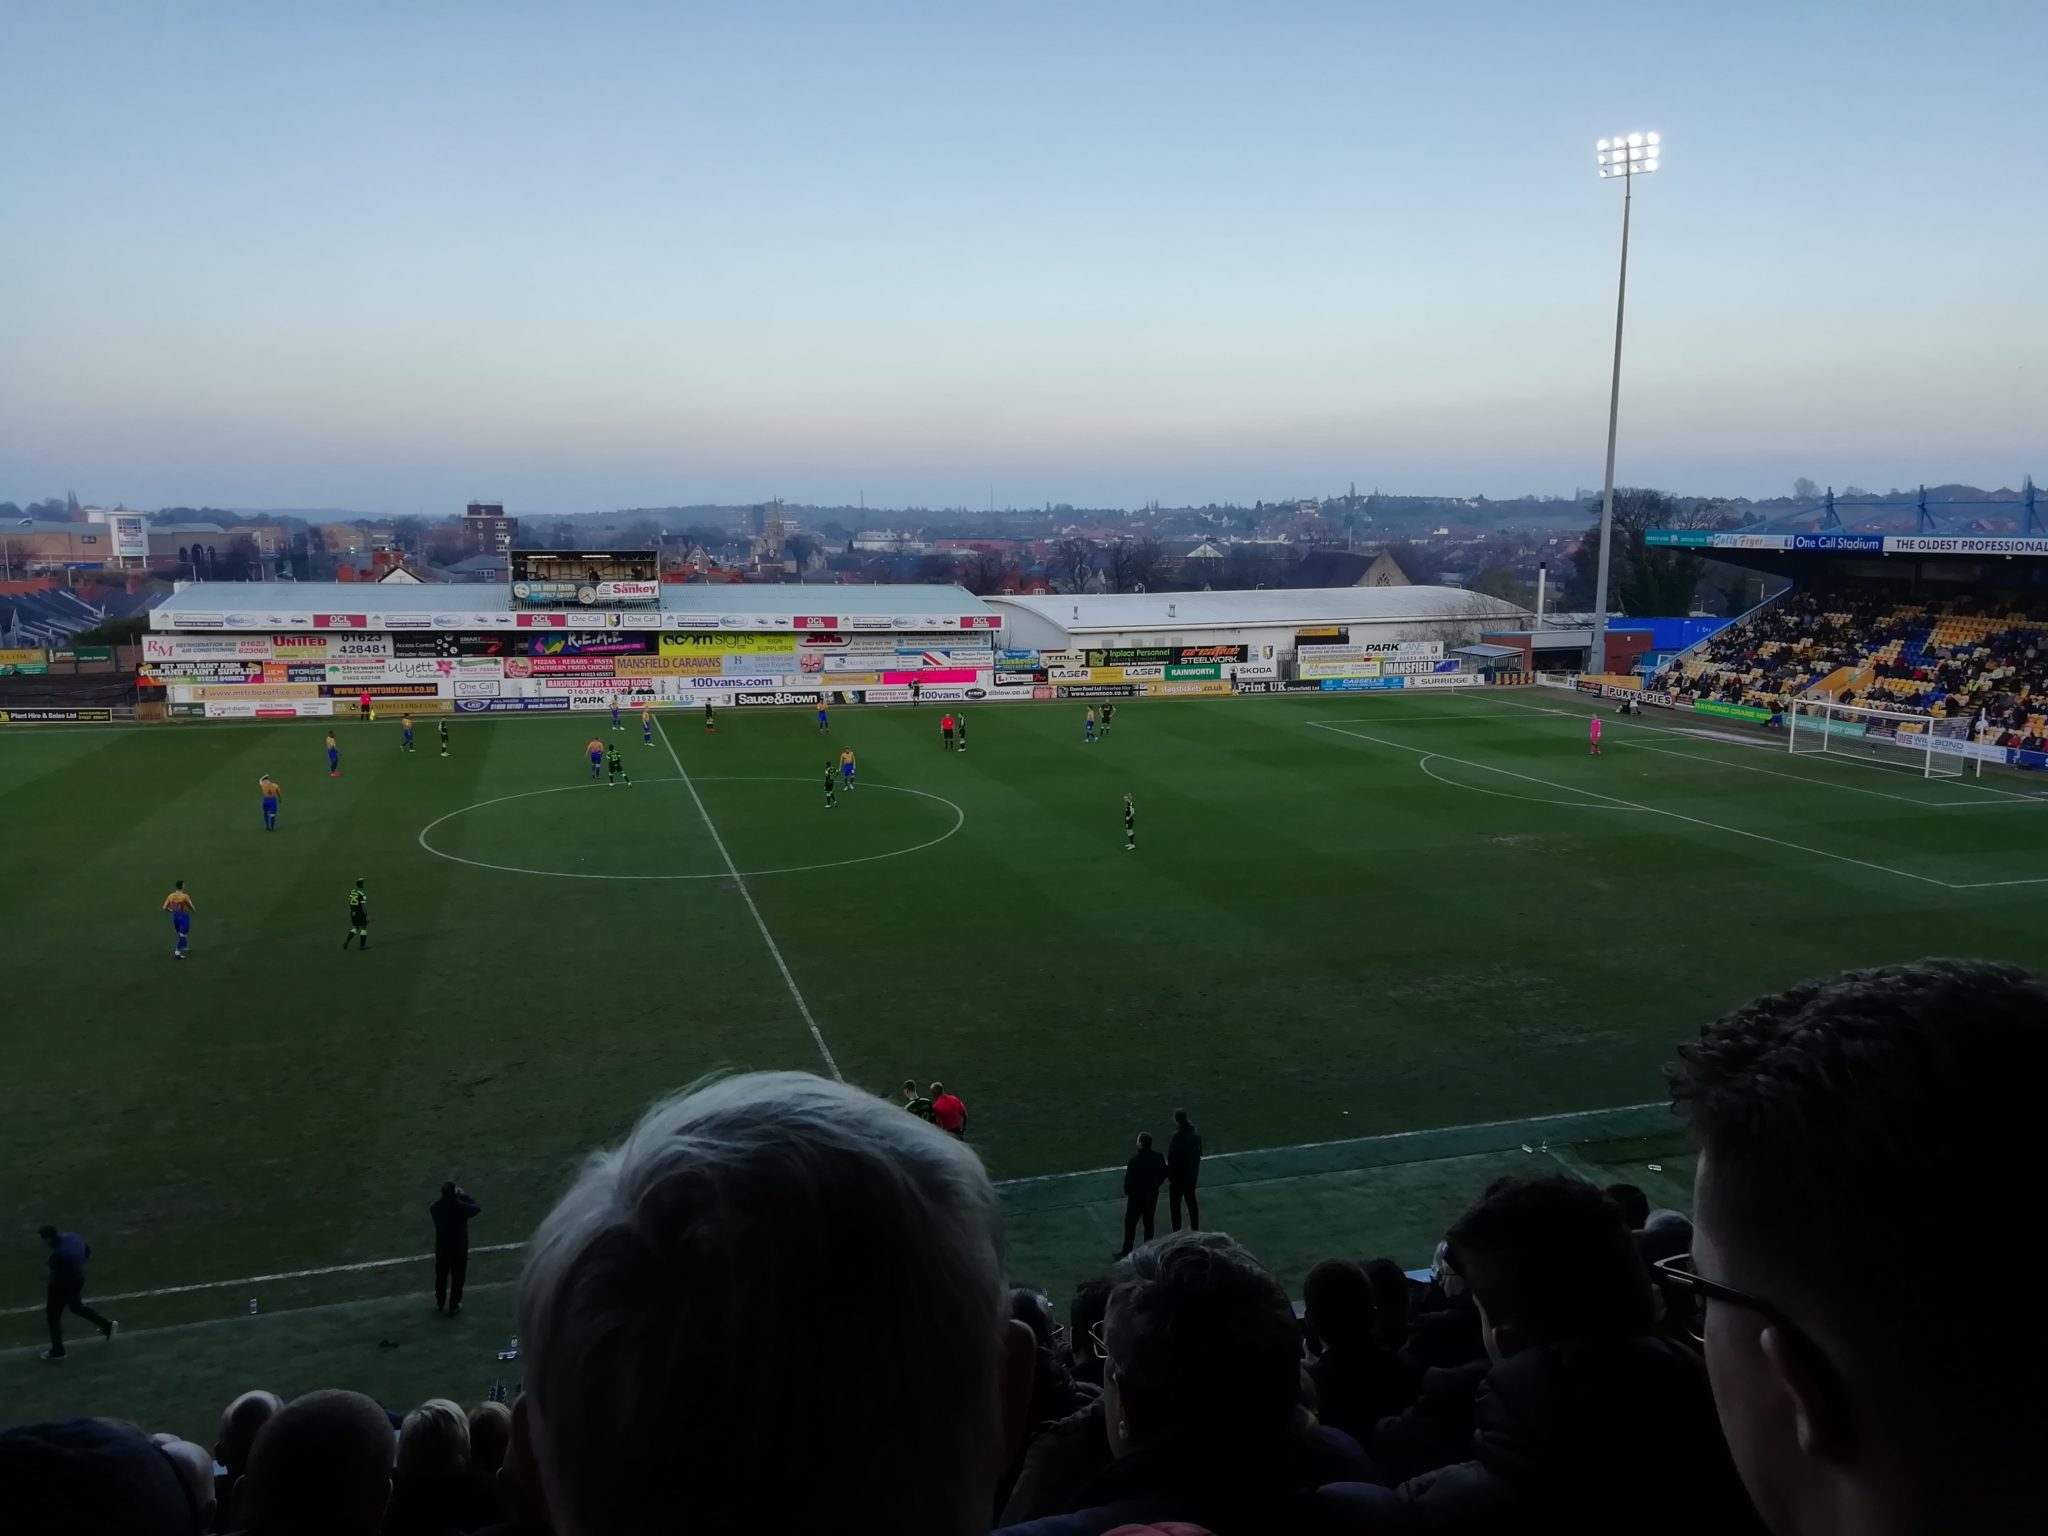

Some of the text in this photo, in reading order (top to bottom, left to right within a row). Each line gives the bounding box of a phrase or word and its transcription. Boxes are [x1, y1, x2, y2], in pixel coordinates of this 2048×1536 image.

[1796, 537, 1879, 550] One Call Stadium
[1896, 539, 2048, 552] THE OLDEST PROFESSIONAL
[612, 583, 656, 594] Sankey
[341, 633, 382, 642] 01623
[663, 633, 755, 649] acorn signs
[339, 645, 387, 654] 428481
[1365, 643, 1400, 652] PARK
[1110, 648, 1170, 658] Inplace Personnel
[617, 656, 721, 669] MANSFIELD CARAVANS
[140, 668, 184, 676] MIDLAND
[1125, 667, 1162, 676] LASER
[1171, 667, 1215, 676] RAINWORTH
[1385, 661, 1435, 674] MANSFIELD
[1051, 670, 1089, 678] LASER
[612, 679, 630, 687] WOOD
[631, 679, 653, 687] FLOORS
[690, 677, 773, 687] 100vans.com
[1420, 677, 1468, 685] SURRIDGE
[333, 685, 437, 695] WWW.OLLERTONSTAGS.CO.UK
[459, 682, 494, 690] One Call
[1160, 684, 1223, 693] stagstickets.co.uk
[1238, 682, 1266, 693] Print
[1269, 681, 1287, 691] UK
[208, 688, 314, 697] www.mtfcboxoffice.co.uk
[920, 690, 960, 700] 100vans
[988, 689, 1031, 697] diblow.co.uk
[573, 696, 605, 704] PARK
[738, 692, 818, 705] Sauce&Brown
[1695, 702, 1730, 714] RAYMOND
[1730, 708, 1755, 718] CRANE
